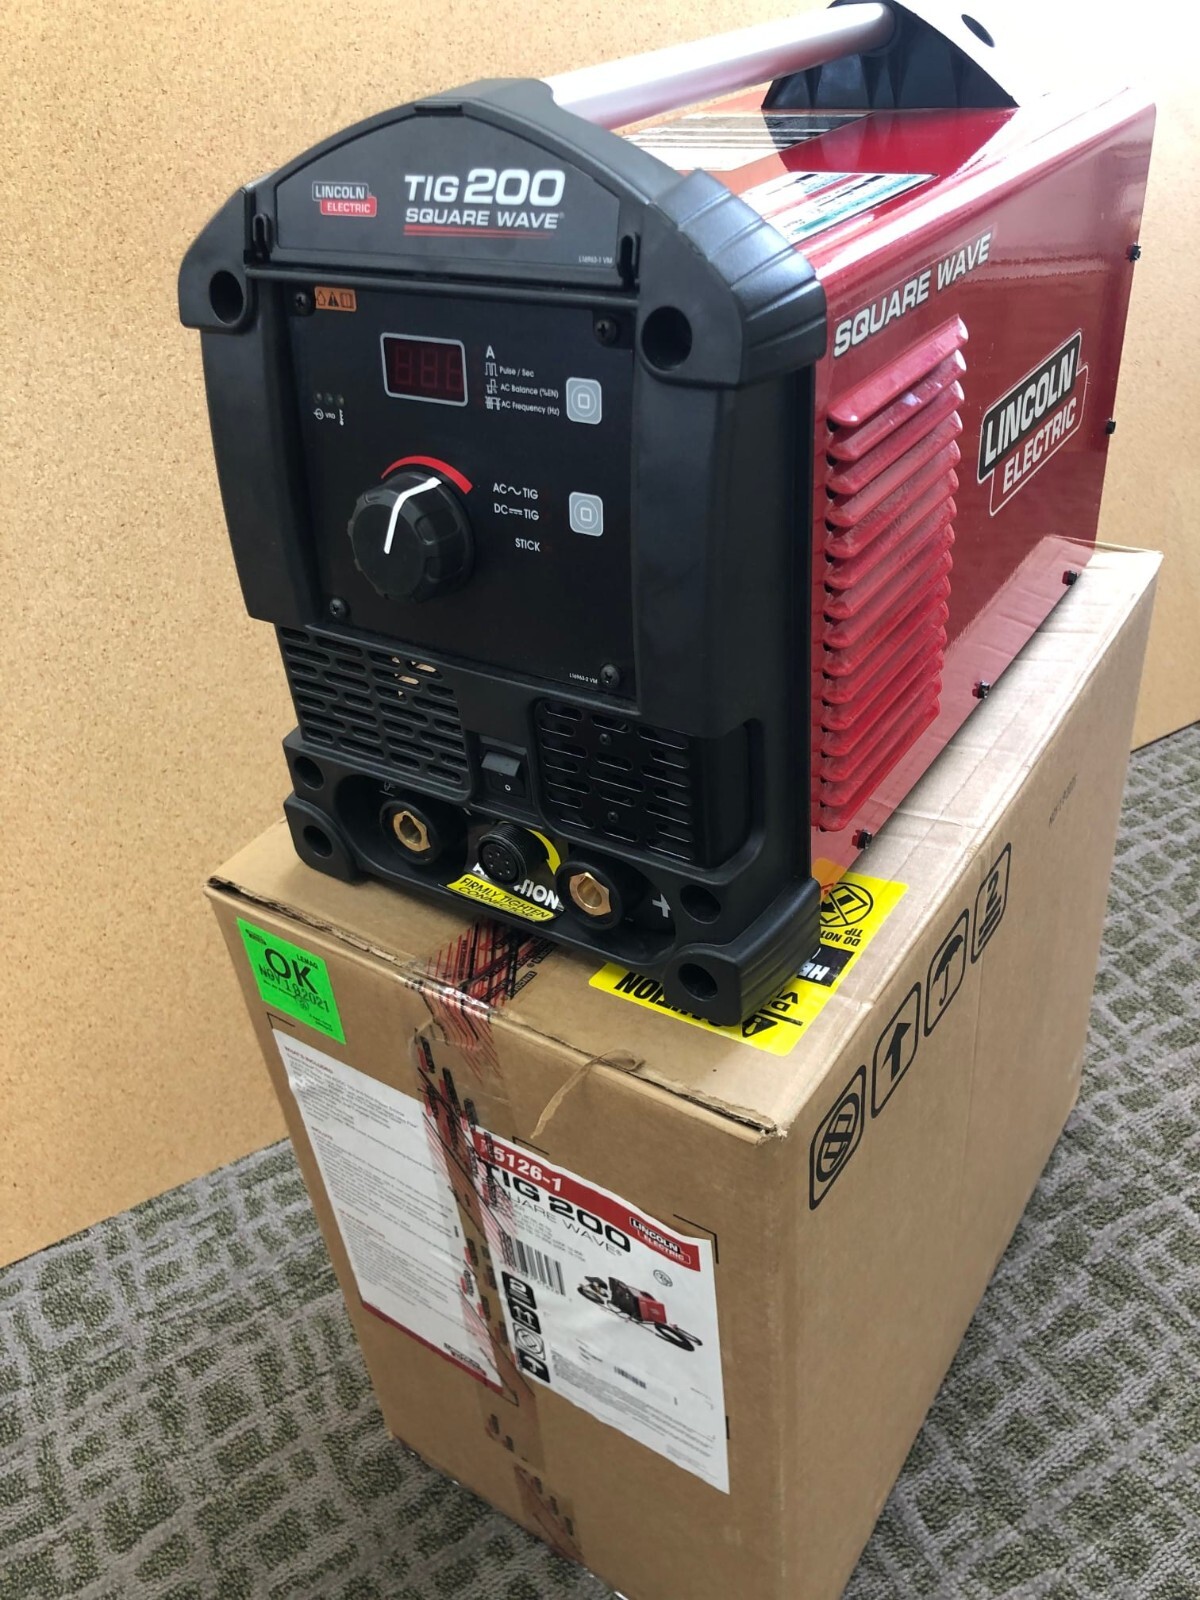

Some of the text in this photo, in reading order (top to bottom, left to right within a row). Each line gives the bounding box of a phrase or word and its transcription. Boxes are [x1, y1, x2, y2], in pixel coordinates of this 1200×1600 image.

[315, 184, 365, 200] LINCOLN
[404, 168, 566, 207] TIG 200
[327, 202, 371, 214] ELECTRIC
[405, 207, 490, 227] SQUARE
[834, 232, 992, 358] SQUARE WAVE
[485, 345, 496, 360] A
[499, 365, 516, 376] Pulse
[521, 368, 535, 378] Sec
[500, 383, 510, 392] AC
[511, 384, 538, 396] Balance
[501, 400, 560, 416] AC Frequency (Hz)
[984, 346, 1076, 468] LINCOLN
[1002, 397, 1077, 494] ELECTRIC
[493, 482, 539, 500] AC TIG
[493, 503, 540, 521] DC TIG
[515, 537, 540, 552] STICK
[460, 876, 550, 919] FIRMLY TIGHTEN
[843, 935, 862, 947] DO
[844, 927, 863, 938] TIP
[264, 947, 319, 995] OK
[479, 1158, 540, 1202] TIG
[548, 1195, 631, 1253] 200
[632, 1219, 680, 1252] LINCOLN
